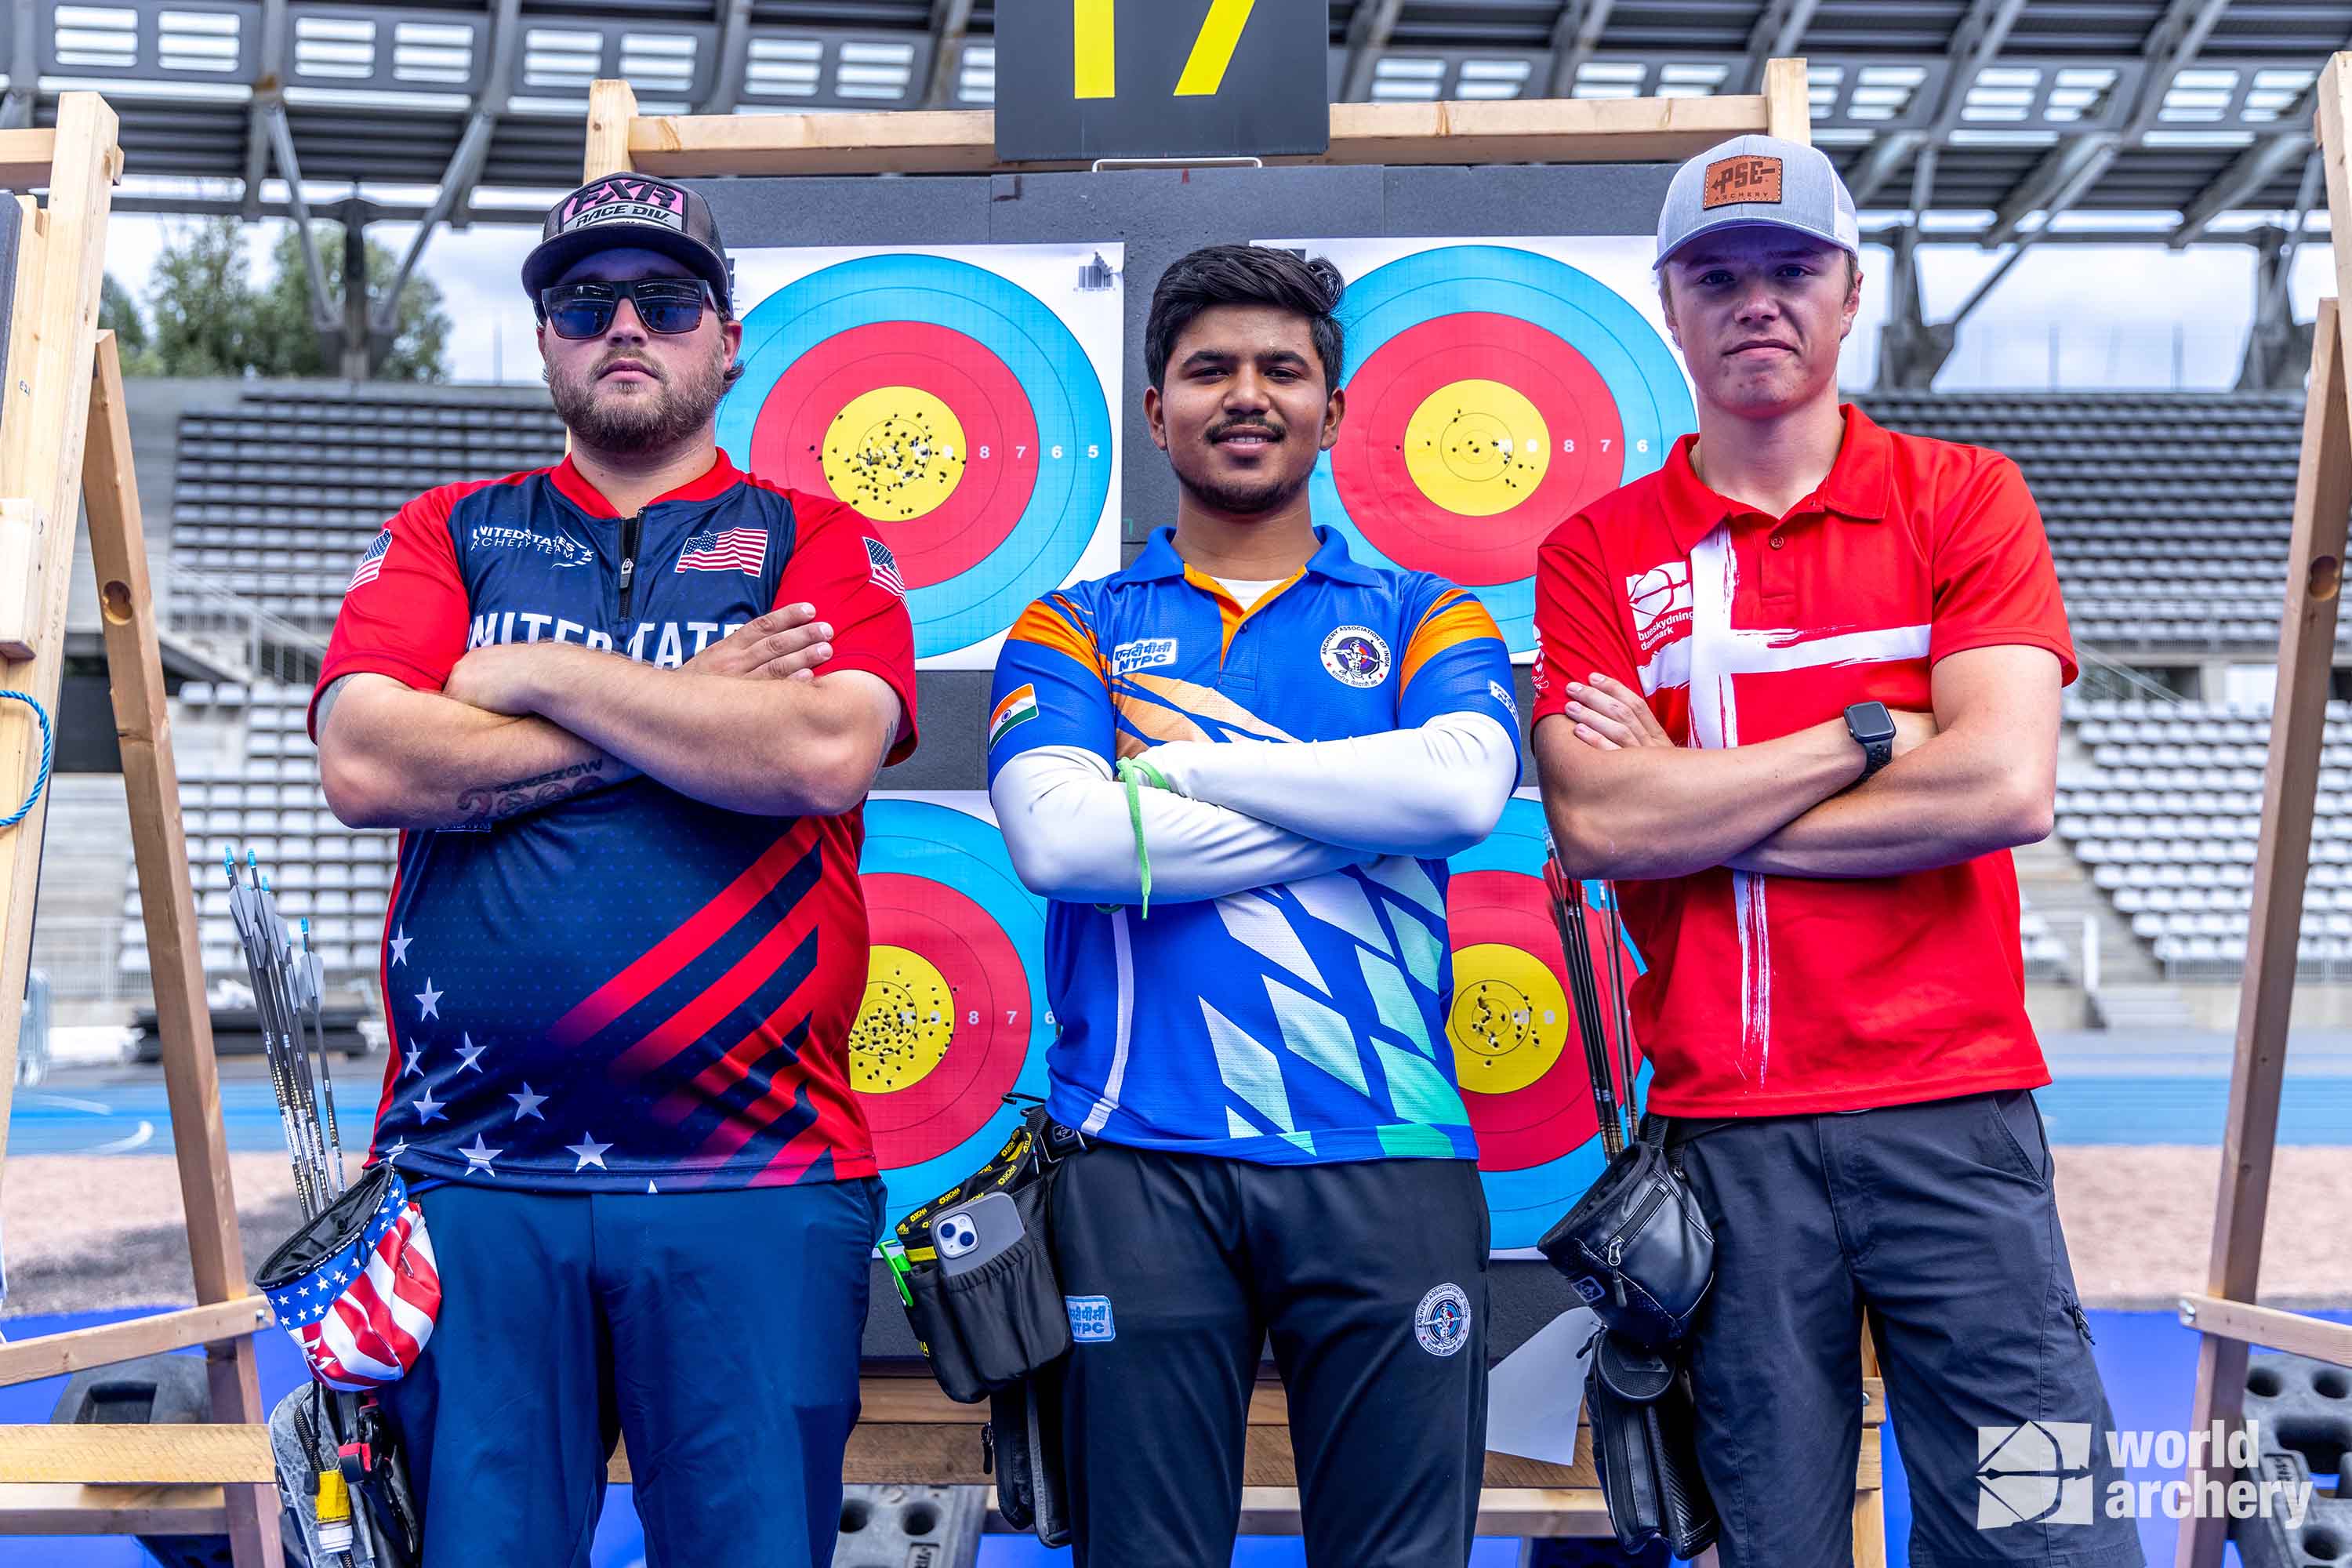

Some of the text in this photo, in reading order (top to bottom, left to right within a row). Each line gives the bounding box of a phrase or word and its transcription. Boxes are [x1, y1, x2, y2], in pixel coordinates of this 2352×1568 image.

[1717, 161, 1764, 194] PSE
[572, 180, 677, 216] FXR
[1714, 192, 1769, 201] ARCHERY
[575, 205, 629, 228] RACE
[978, 445, 990, 459] 8
[1016, 445, 1027, 459] 7
[1051, 445, 1063, 459] 6
[1087, 445, 1099, 459] 5
[1563, 439, 1574, 452] 8
[1600, 439, 1612, 452] 7
[1636, 439, 1649, 452] 6
[536, 543, 574, 559] TEAM
[467, 612, 613, 654] NITED
[1322, 630, 1338, 655] ARCHERY
[1339, 626, 1381, 642] ASSOCIATION
[1379, 641, 1387, 649] OF
[1118, 654, 1167, 672] NTPC
[968, 1011, 980, 1025] 8
[1006, 1011, 1018, 1025] 7
[1044, 1010, 1056, 1025] 6
